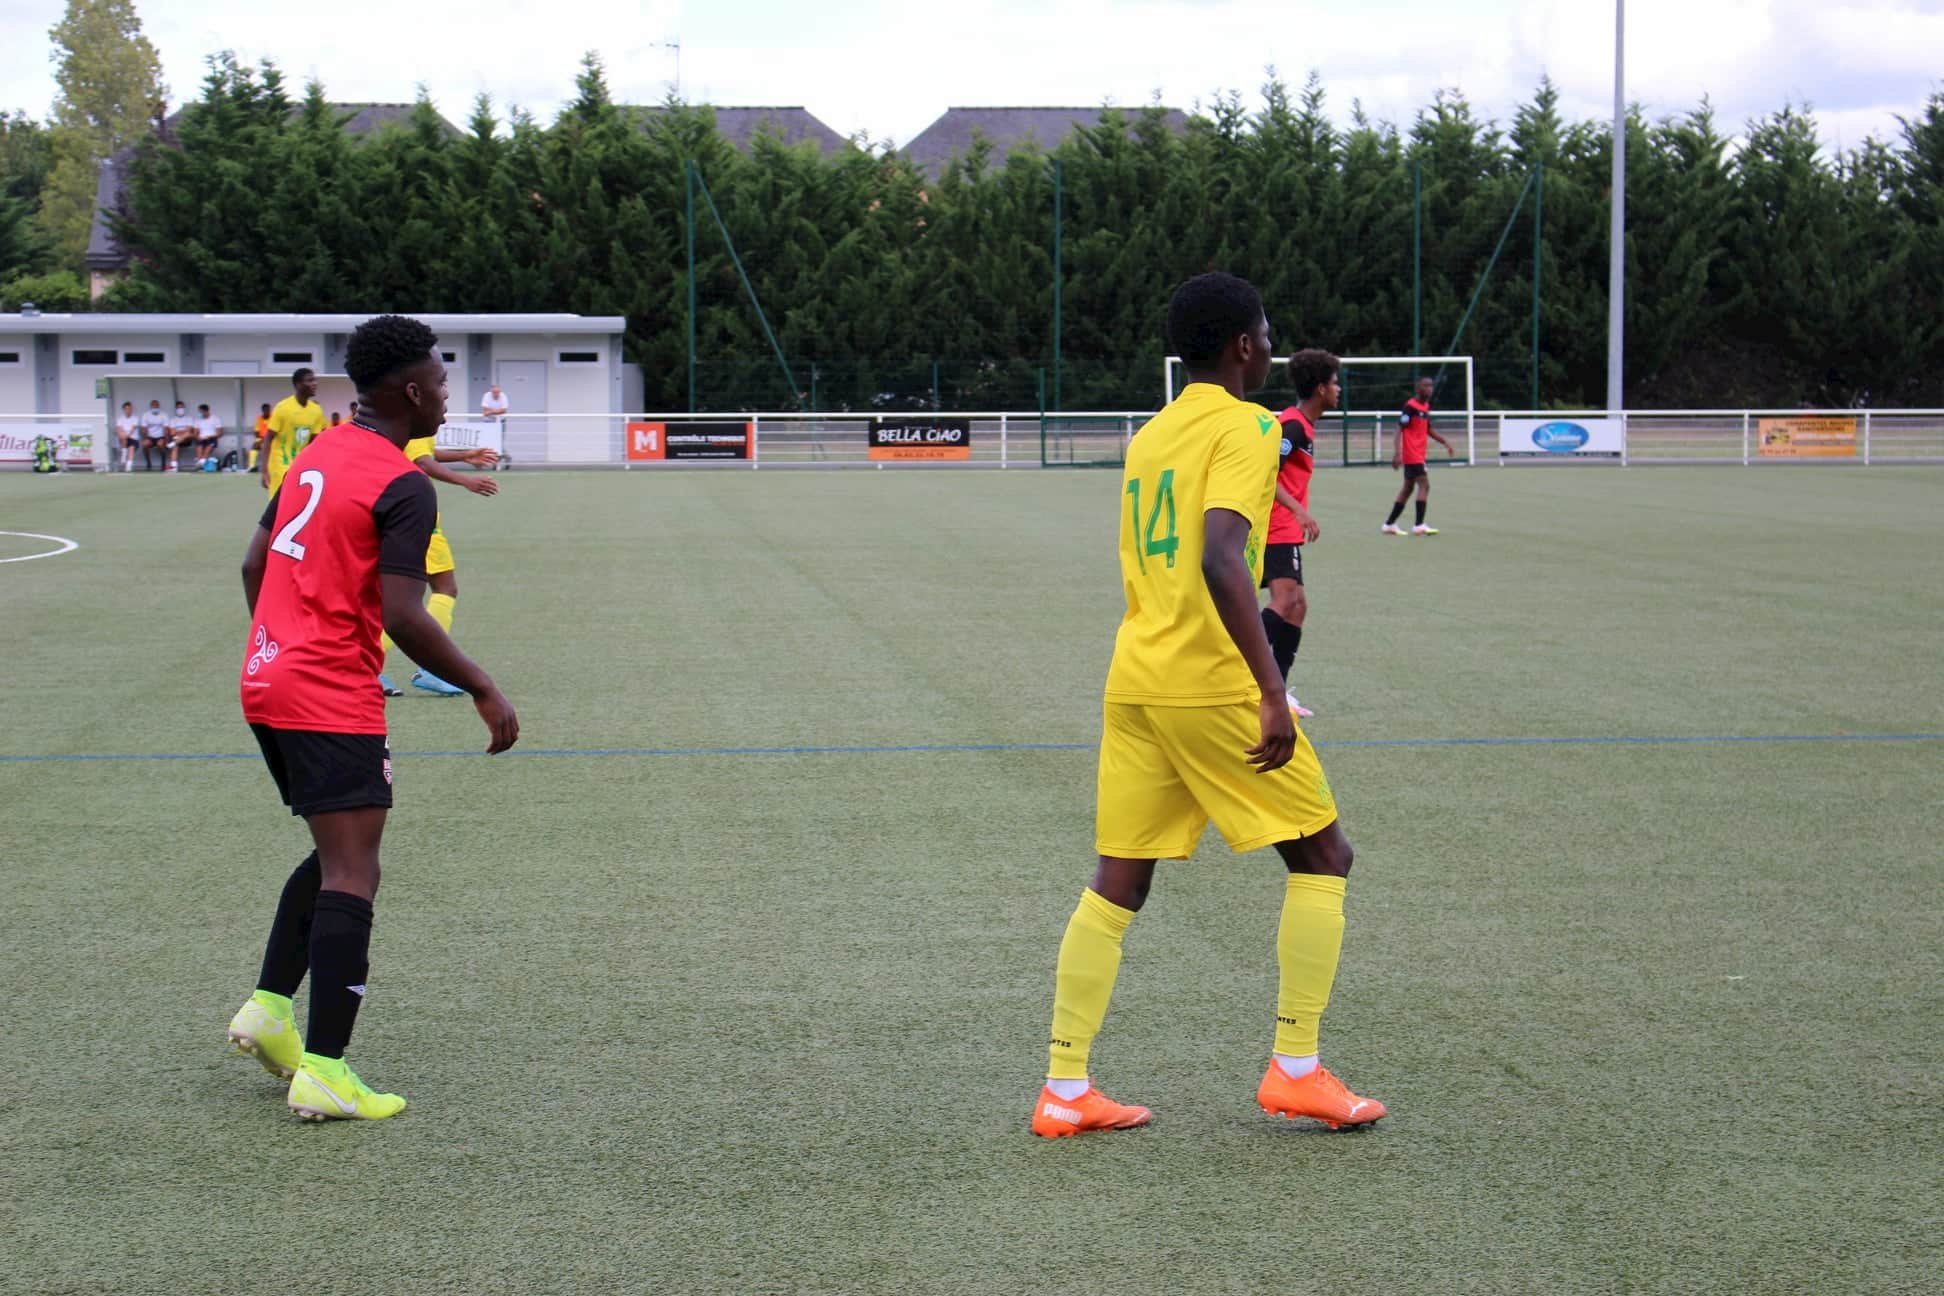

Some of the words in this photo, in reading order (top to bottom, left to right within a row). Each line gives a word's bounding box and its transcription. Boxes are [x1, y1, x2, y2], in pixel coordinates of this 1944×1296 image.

[877, 428, 922, 442] BELLA
[270, 470, 324, 561] 2
[1126, 469, 1180, 577] 14
